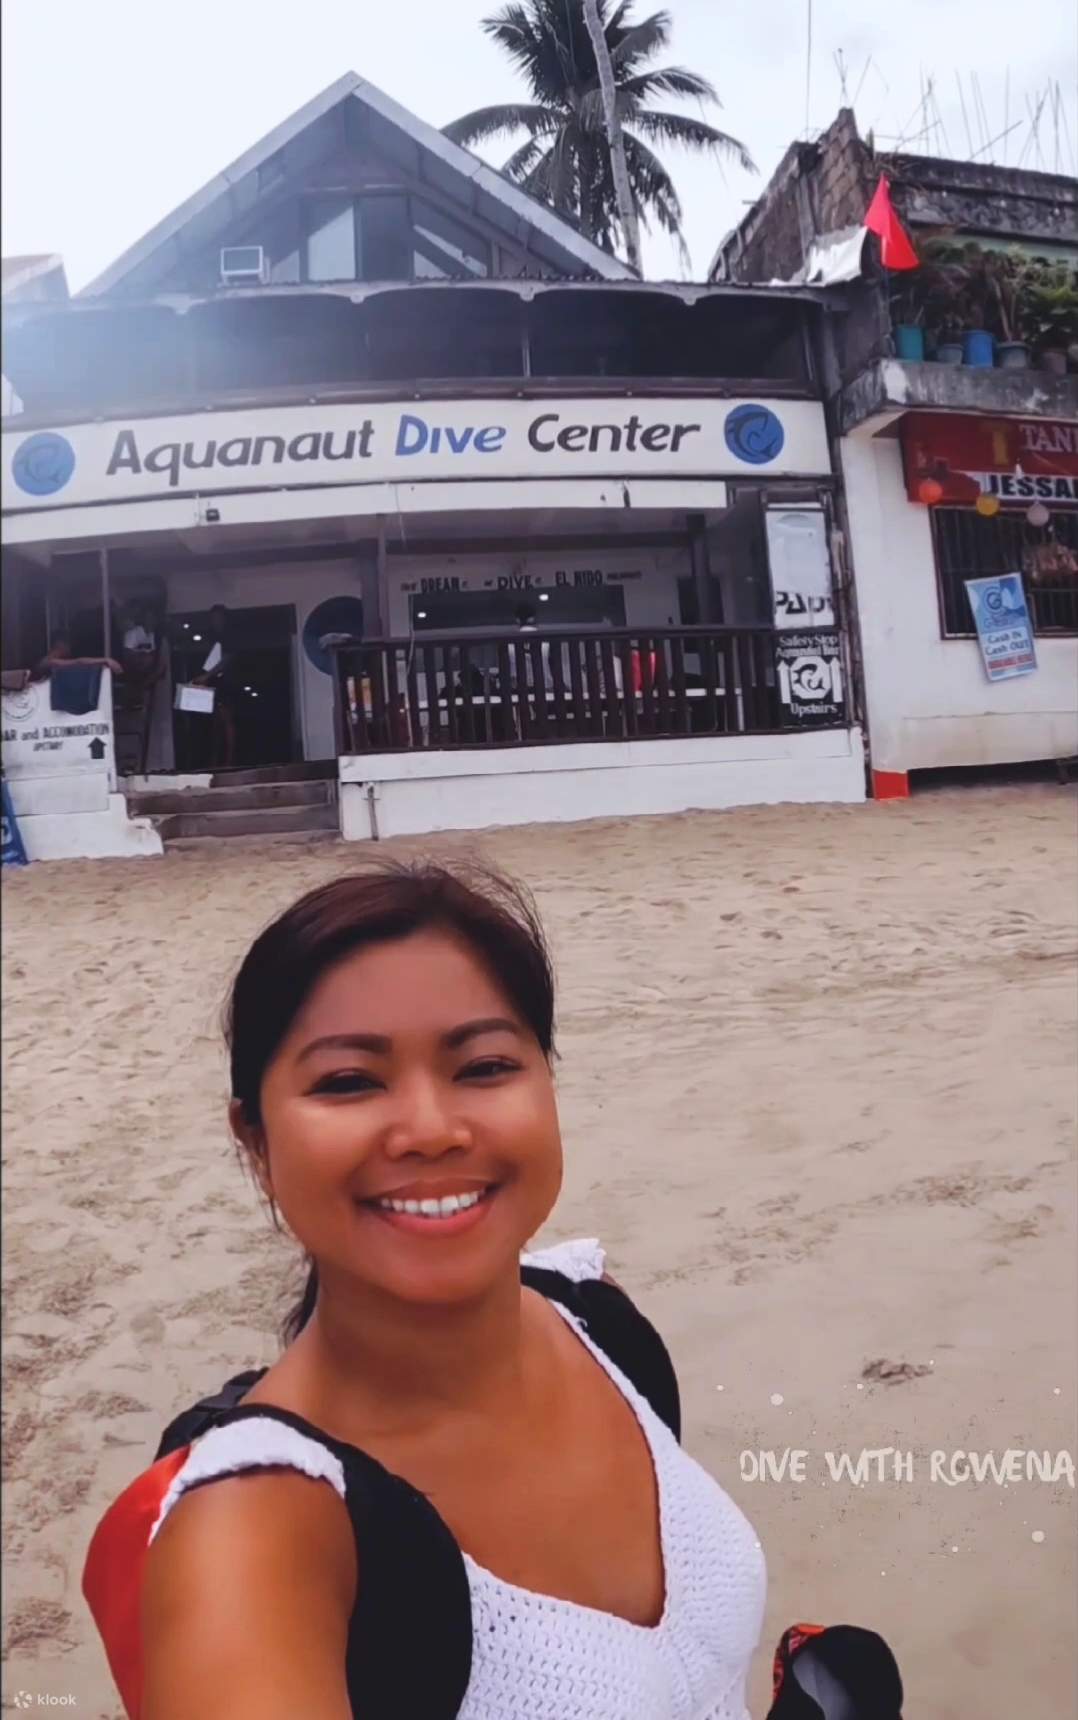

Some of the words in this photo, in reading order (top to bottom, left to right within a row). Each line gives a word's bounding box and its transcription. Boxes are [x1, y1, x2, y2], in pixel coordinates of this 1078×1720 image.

[105, 419, 375, 487] Aquanaut
[394, 414, 507, 456] Dive
[527, 413, 701, 453] Center
